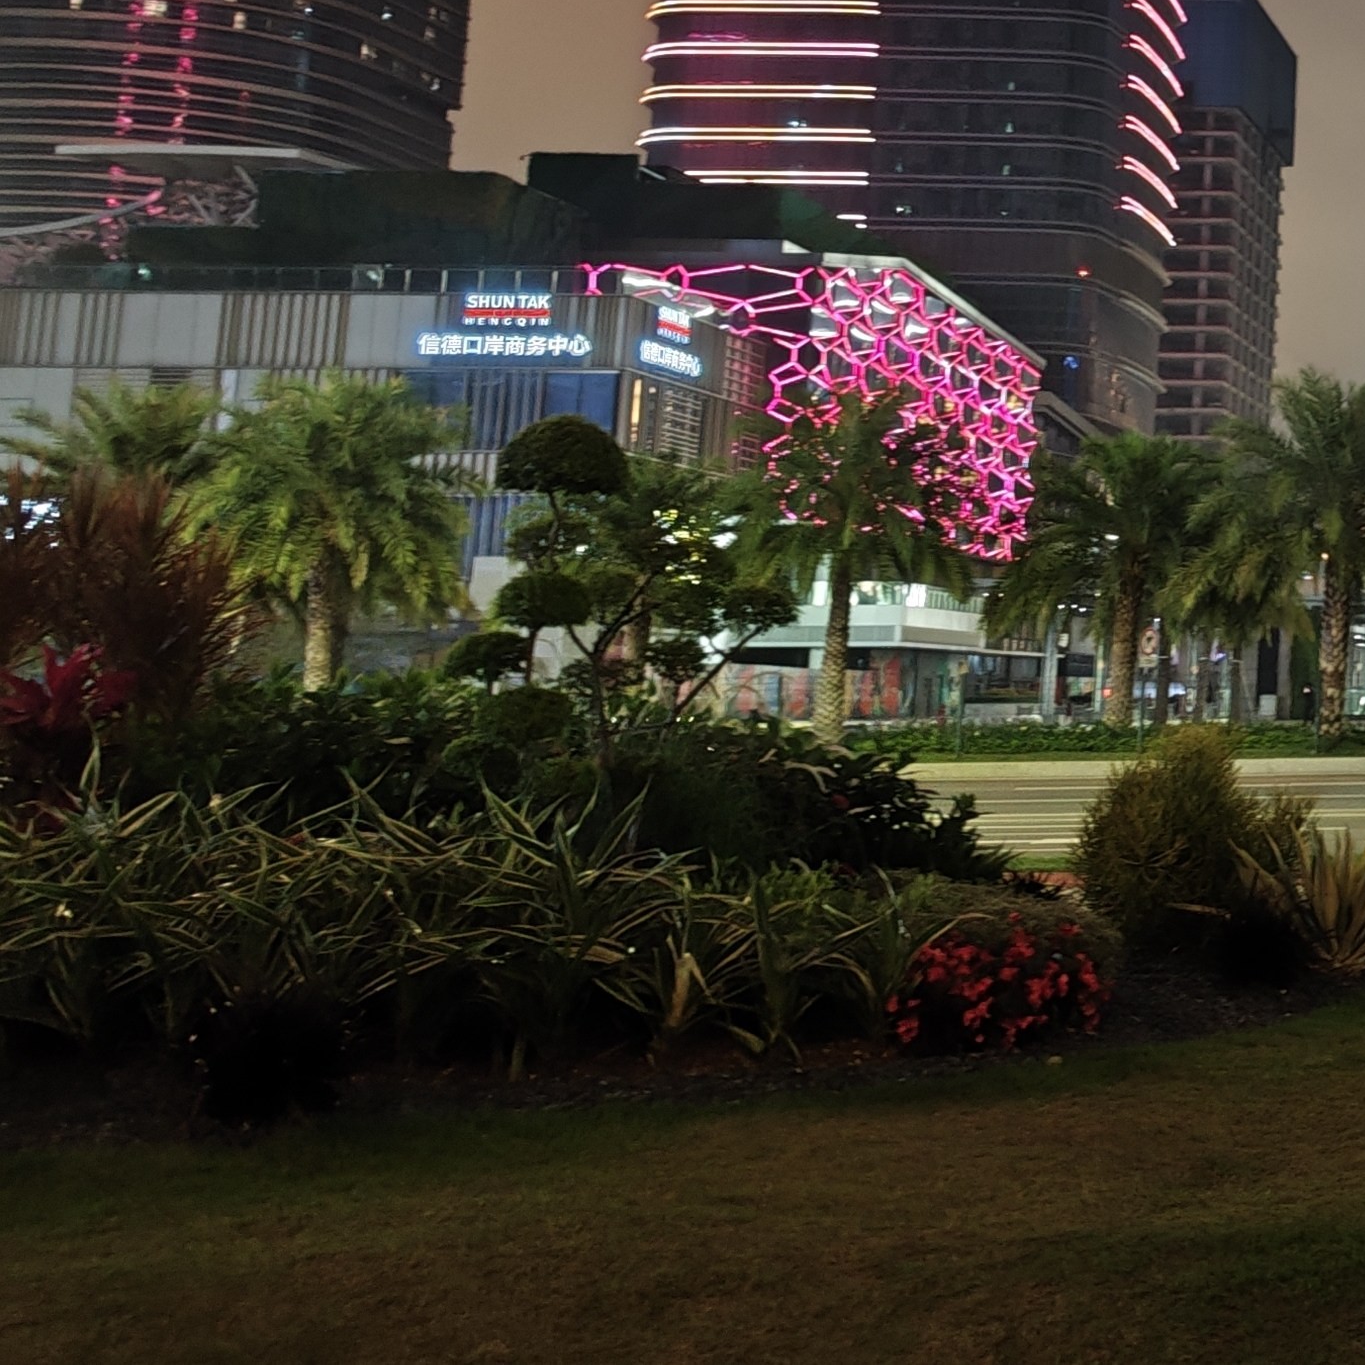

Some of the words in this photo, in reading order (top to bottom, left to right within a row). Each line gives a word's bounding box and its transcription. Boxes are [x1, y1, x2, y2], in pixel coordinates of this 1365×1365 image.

[466, 294, 517, 309] SHUN
[517, 295, 550, 309] TAK
[417, 334, 592, 357] 信德口岸商务中心
